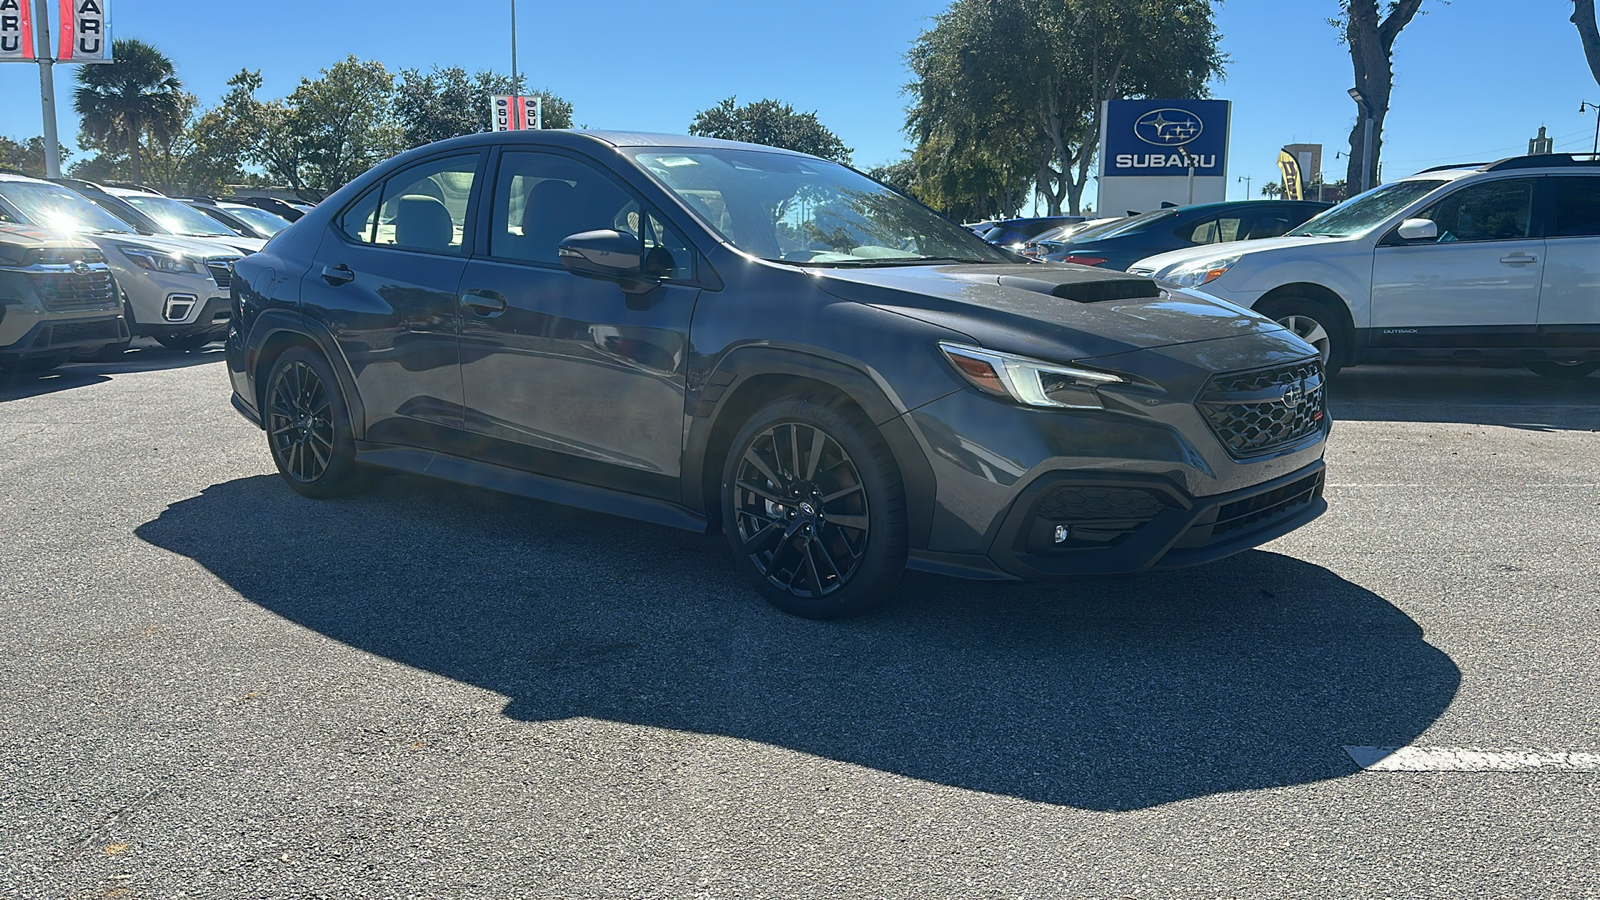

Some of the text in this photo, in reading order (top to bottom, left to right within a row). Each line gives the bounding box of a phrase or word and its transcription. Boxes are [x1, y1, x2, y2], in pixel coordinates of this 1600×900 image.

[79, 0, 101, 53] ARU
[527, 110, 536, 130] SU
[1116, 154, 1216, 168] SUBARU
